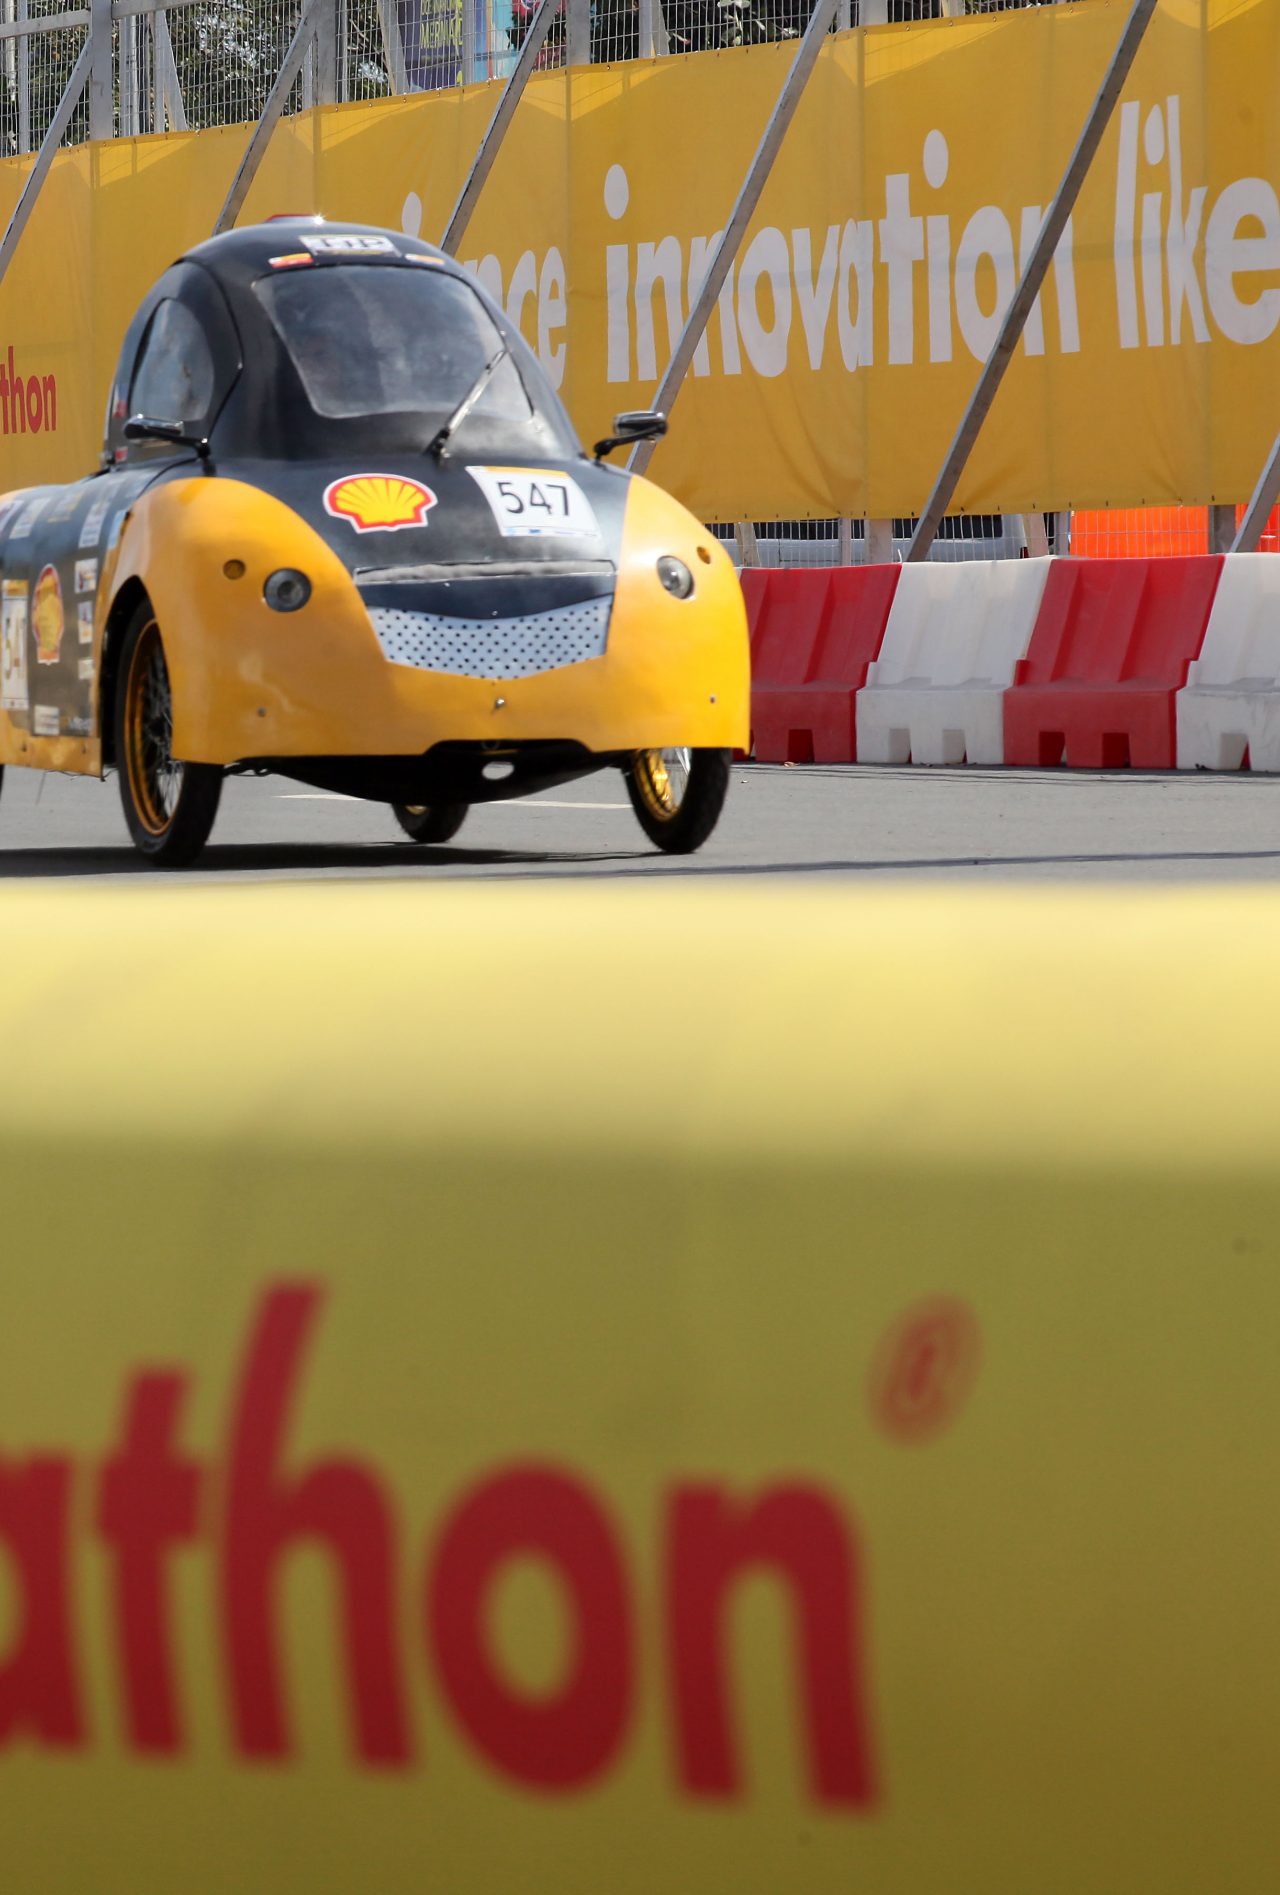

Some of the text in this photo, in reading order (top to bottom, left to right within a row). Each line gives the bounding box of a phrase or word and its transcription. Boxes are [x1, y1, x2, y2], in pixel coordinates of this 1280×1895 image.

[604, 130, 1080, 378] innovation
[1114, 95, 1280, 345] like
[496, 481, 569, 516] 547
